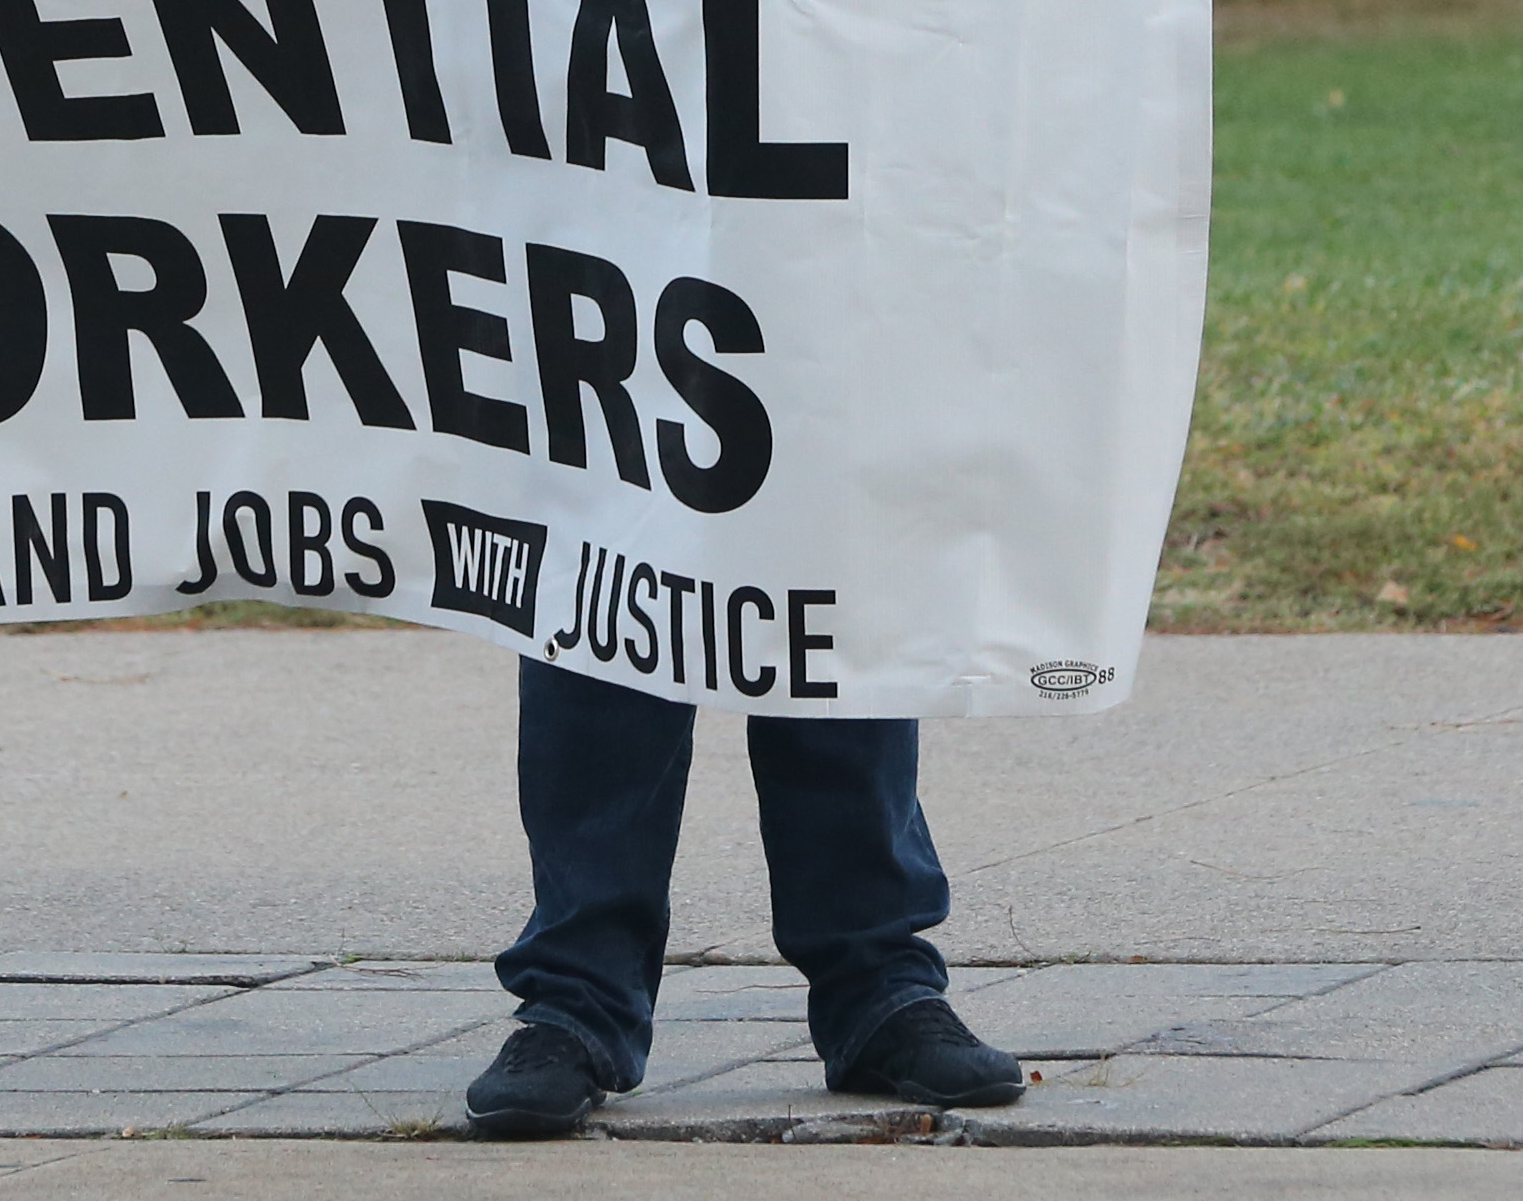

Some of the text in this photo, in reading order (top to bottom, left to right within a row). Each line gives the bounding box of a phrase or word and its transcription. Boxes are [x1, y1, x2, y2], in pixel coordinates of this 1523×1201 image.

[175, 490, 396, 599] JOBS
[446, 522, 531, 609] WITH
[554, 541, 838, 700] JUSTICE
[1030, 659, 1099, 674] MADISON GRAPHICS
[1038, 666, 1115, 686] GCC/IBT 88
